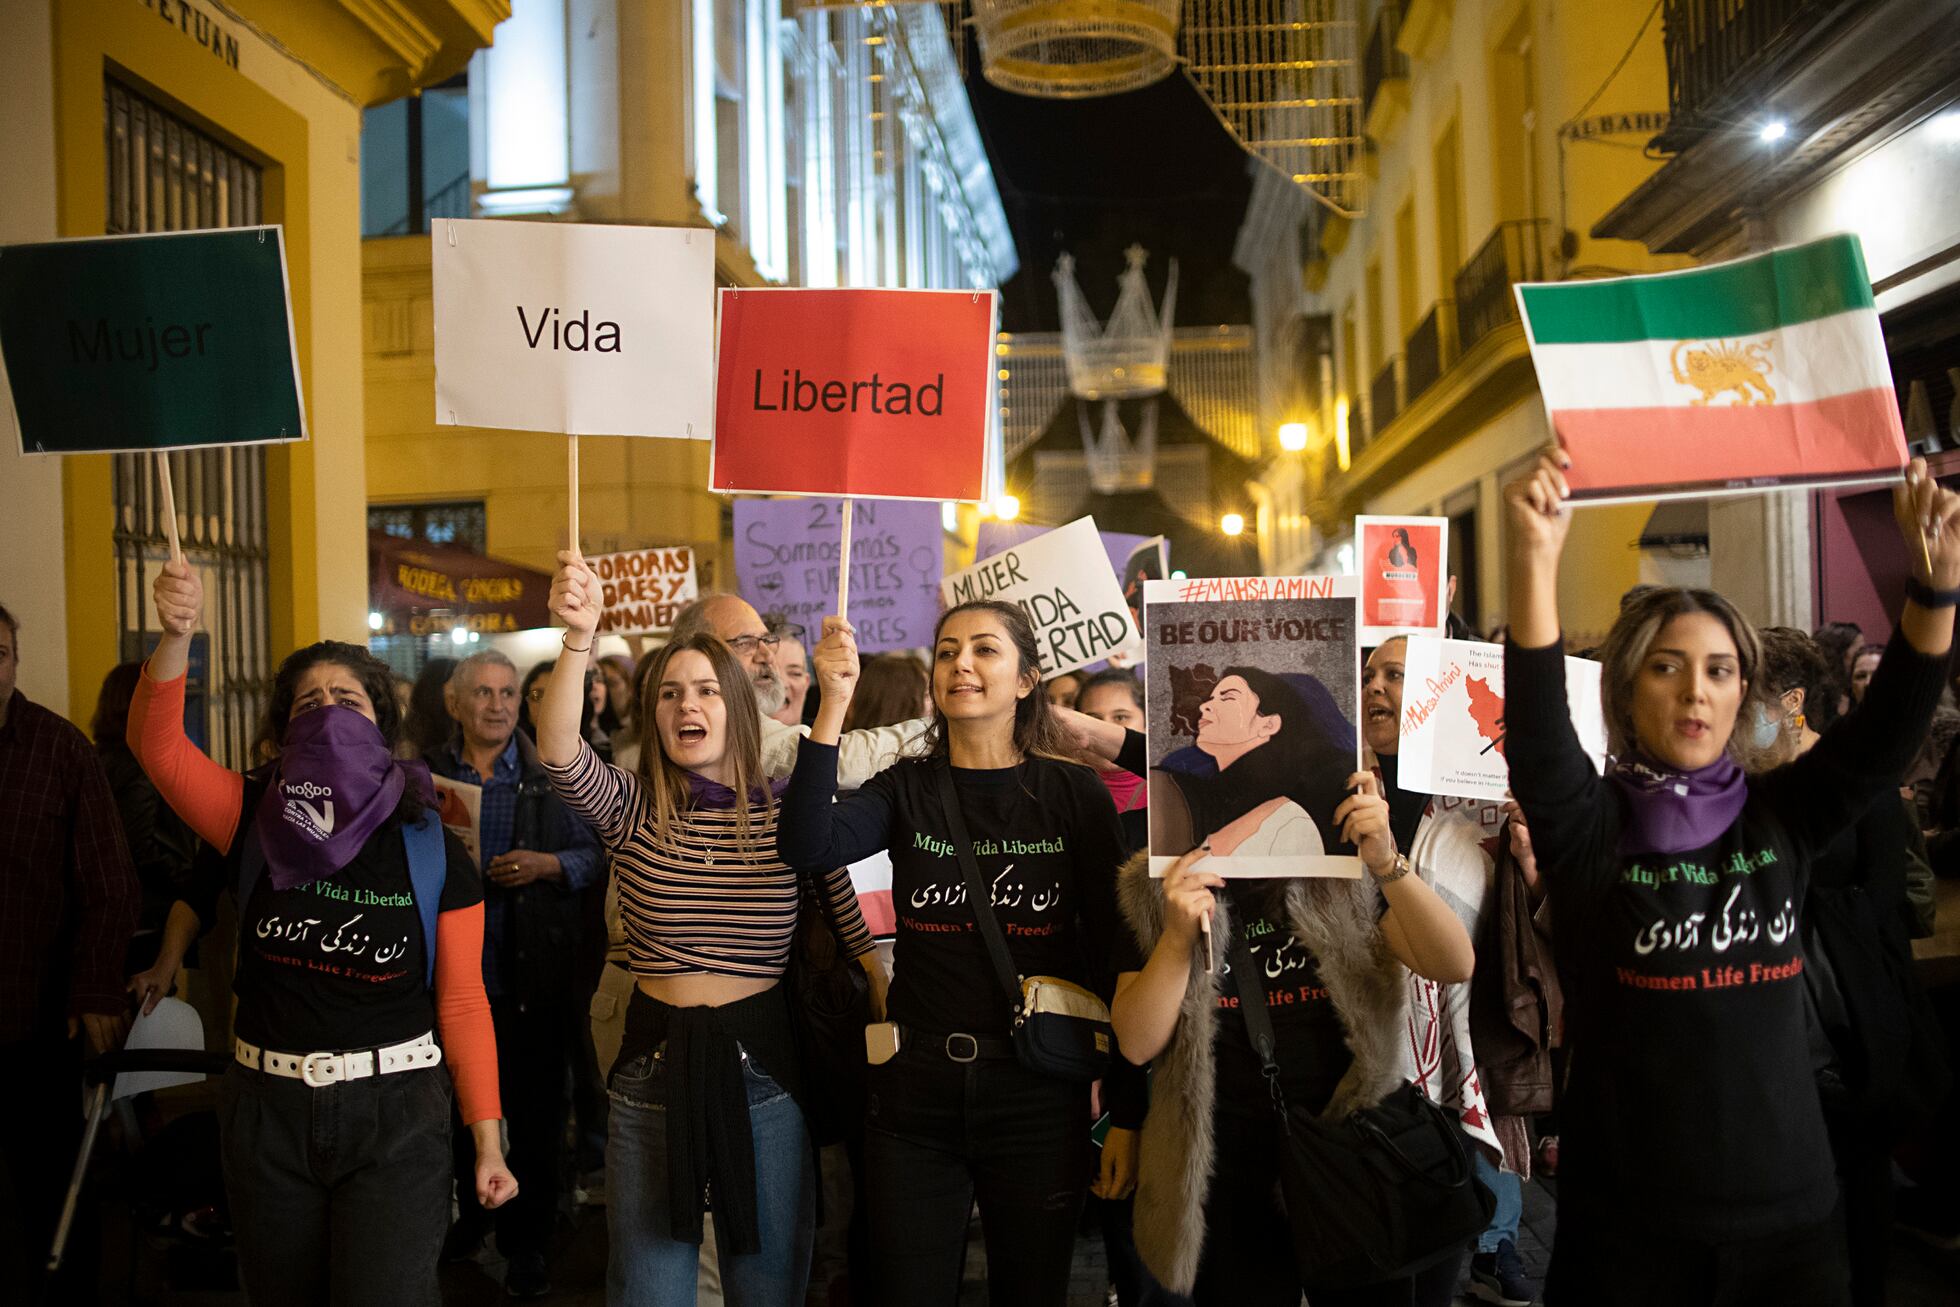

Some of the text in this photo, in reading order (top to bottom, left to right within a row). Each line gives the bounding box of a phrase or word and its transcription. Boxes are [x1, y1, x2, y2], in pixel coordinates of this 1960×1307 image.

[146, 0, 240, 70] ETUAN
[516, 305, 622, 353] Vida
[65, 316, 212, 372] Mujer
[752, 368, 945, 417] Libertad
[668, 577, 685, 600] Y
[953, 552, 1028, 604] MUJER
[1179, 576, 1334, 603] #MAHSA AMINI
[1035, 611, 1128, 676] ERTAD
[1159, 616, 1347, 646] BE OUR VOICE
[1484, 651, 1504, 660] Islam
[913, 831, 957, 859] Muje
[1002, 836, 1065, 856] Libertad
[1680, 861, 1720, 886] Vida
[315, 879, 350, 902] Vida
[353, 889, 414, 907] Libertad
[1031, 881, 1060, 912] زن
[256, 913, 408, 964] زن زندگی آزادی
[901, 915, 961, 933] Women
[1007, 921, 1059, 937] Freed
[1616, 965, 1697, 991] Women
[1701, 963, 1745, 989] Life
[1265, 987, 1294, 1007] ife
